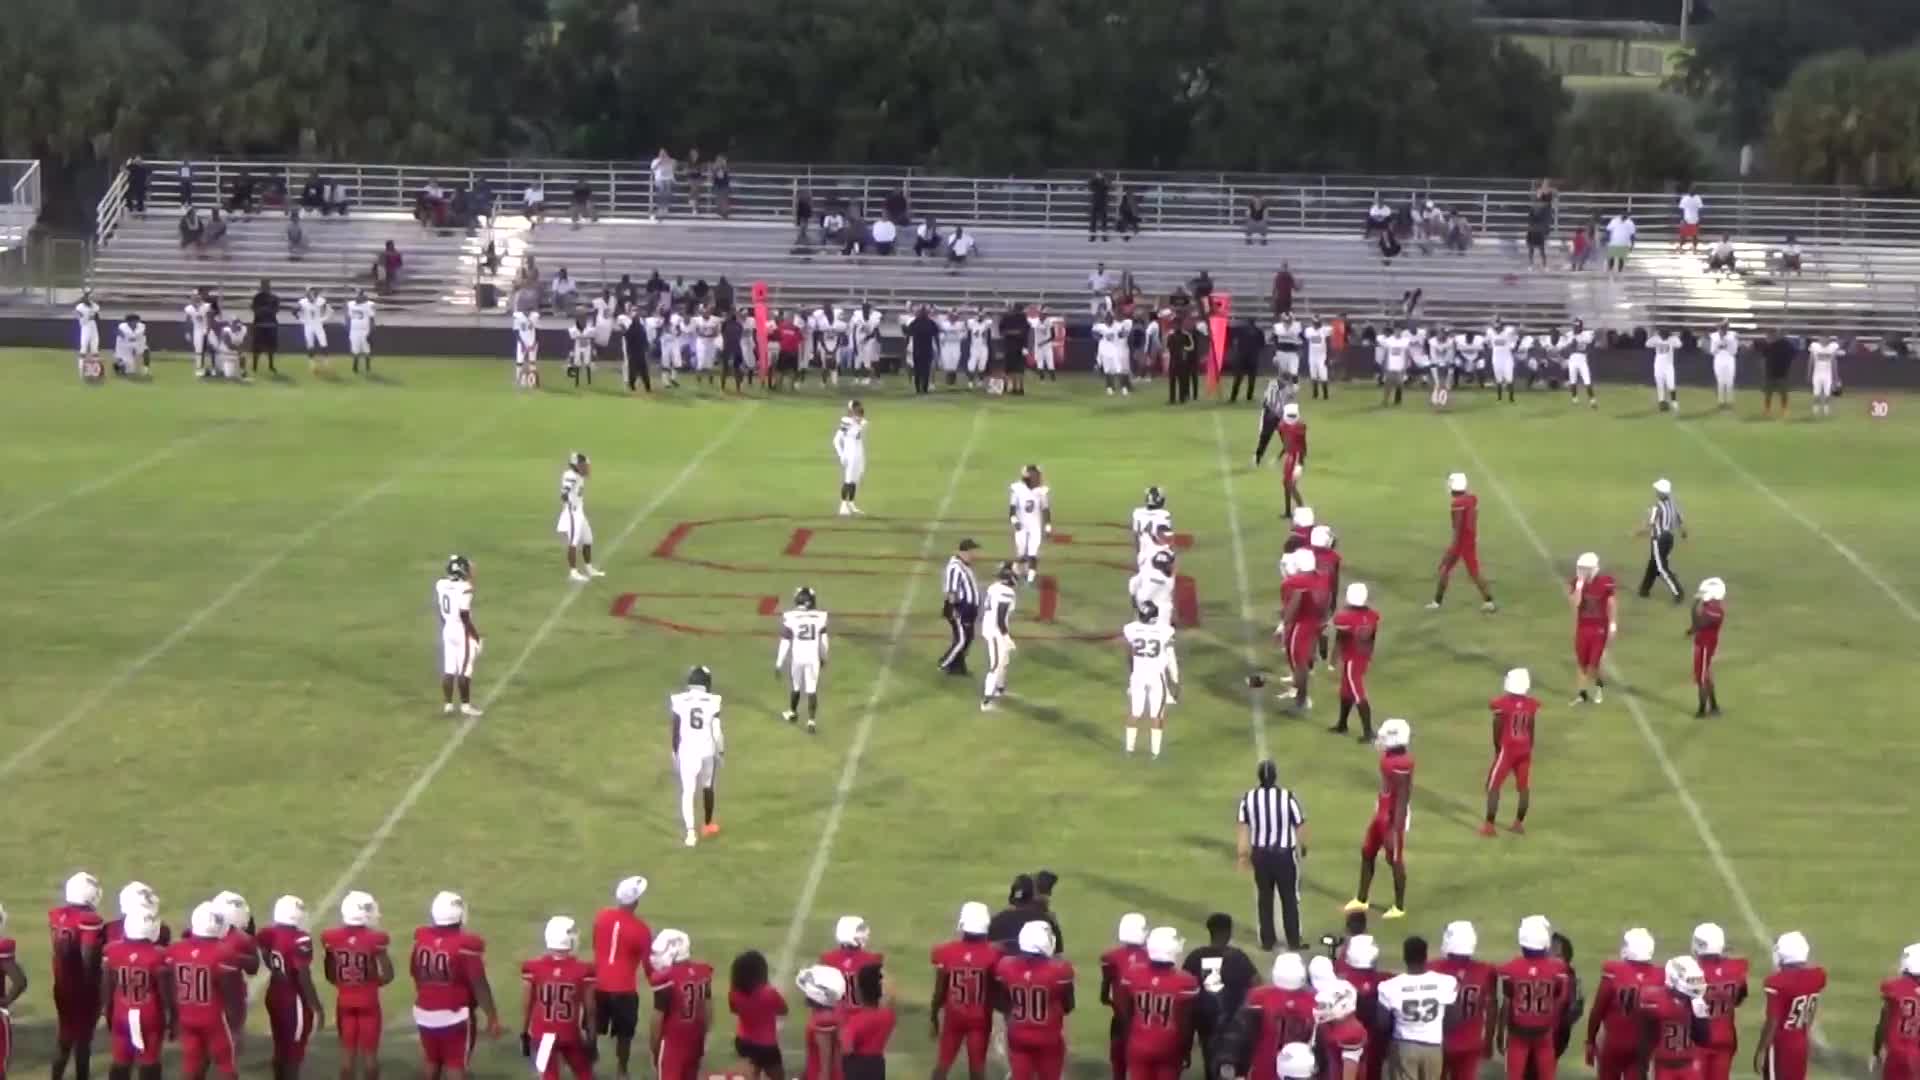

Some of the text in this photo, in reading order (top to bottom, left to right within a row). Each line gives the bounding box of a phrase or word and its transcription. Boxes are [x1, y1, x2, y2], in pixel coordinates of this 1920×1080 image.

[1871, 401, 1888, 417] 30
[797, 623, 816, 641] 21
[1133, 637, 1161, 658] 23
[690, 707, 704, 730] 6
[335, 949, 369, 984] 29
[175, 963, 211, 1006] 50
[949, 967, 985, 1008] 57
[537, 983, 576, 1022] 45
[1010, 984, 1049, 1025] 90
[1135, 991, 1174, 1028] 44
[1401, 998, 1439, 1023] 53
